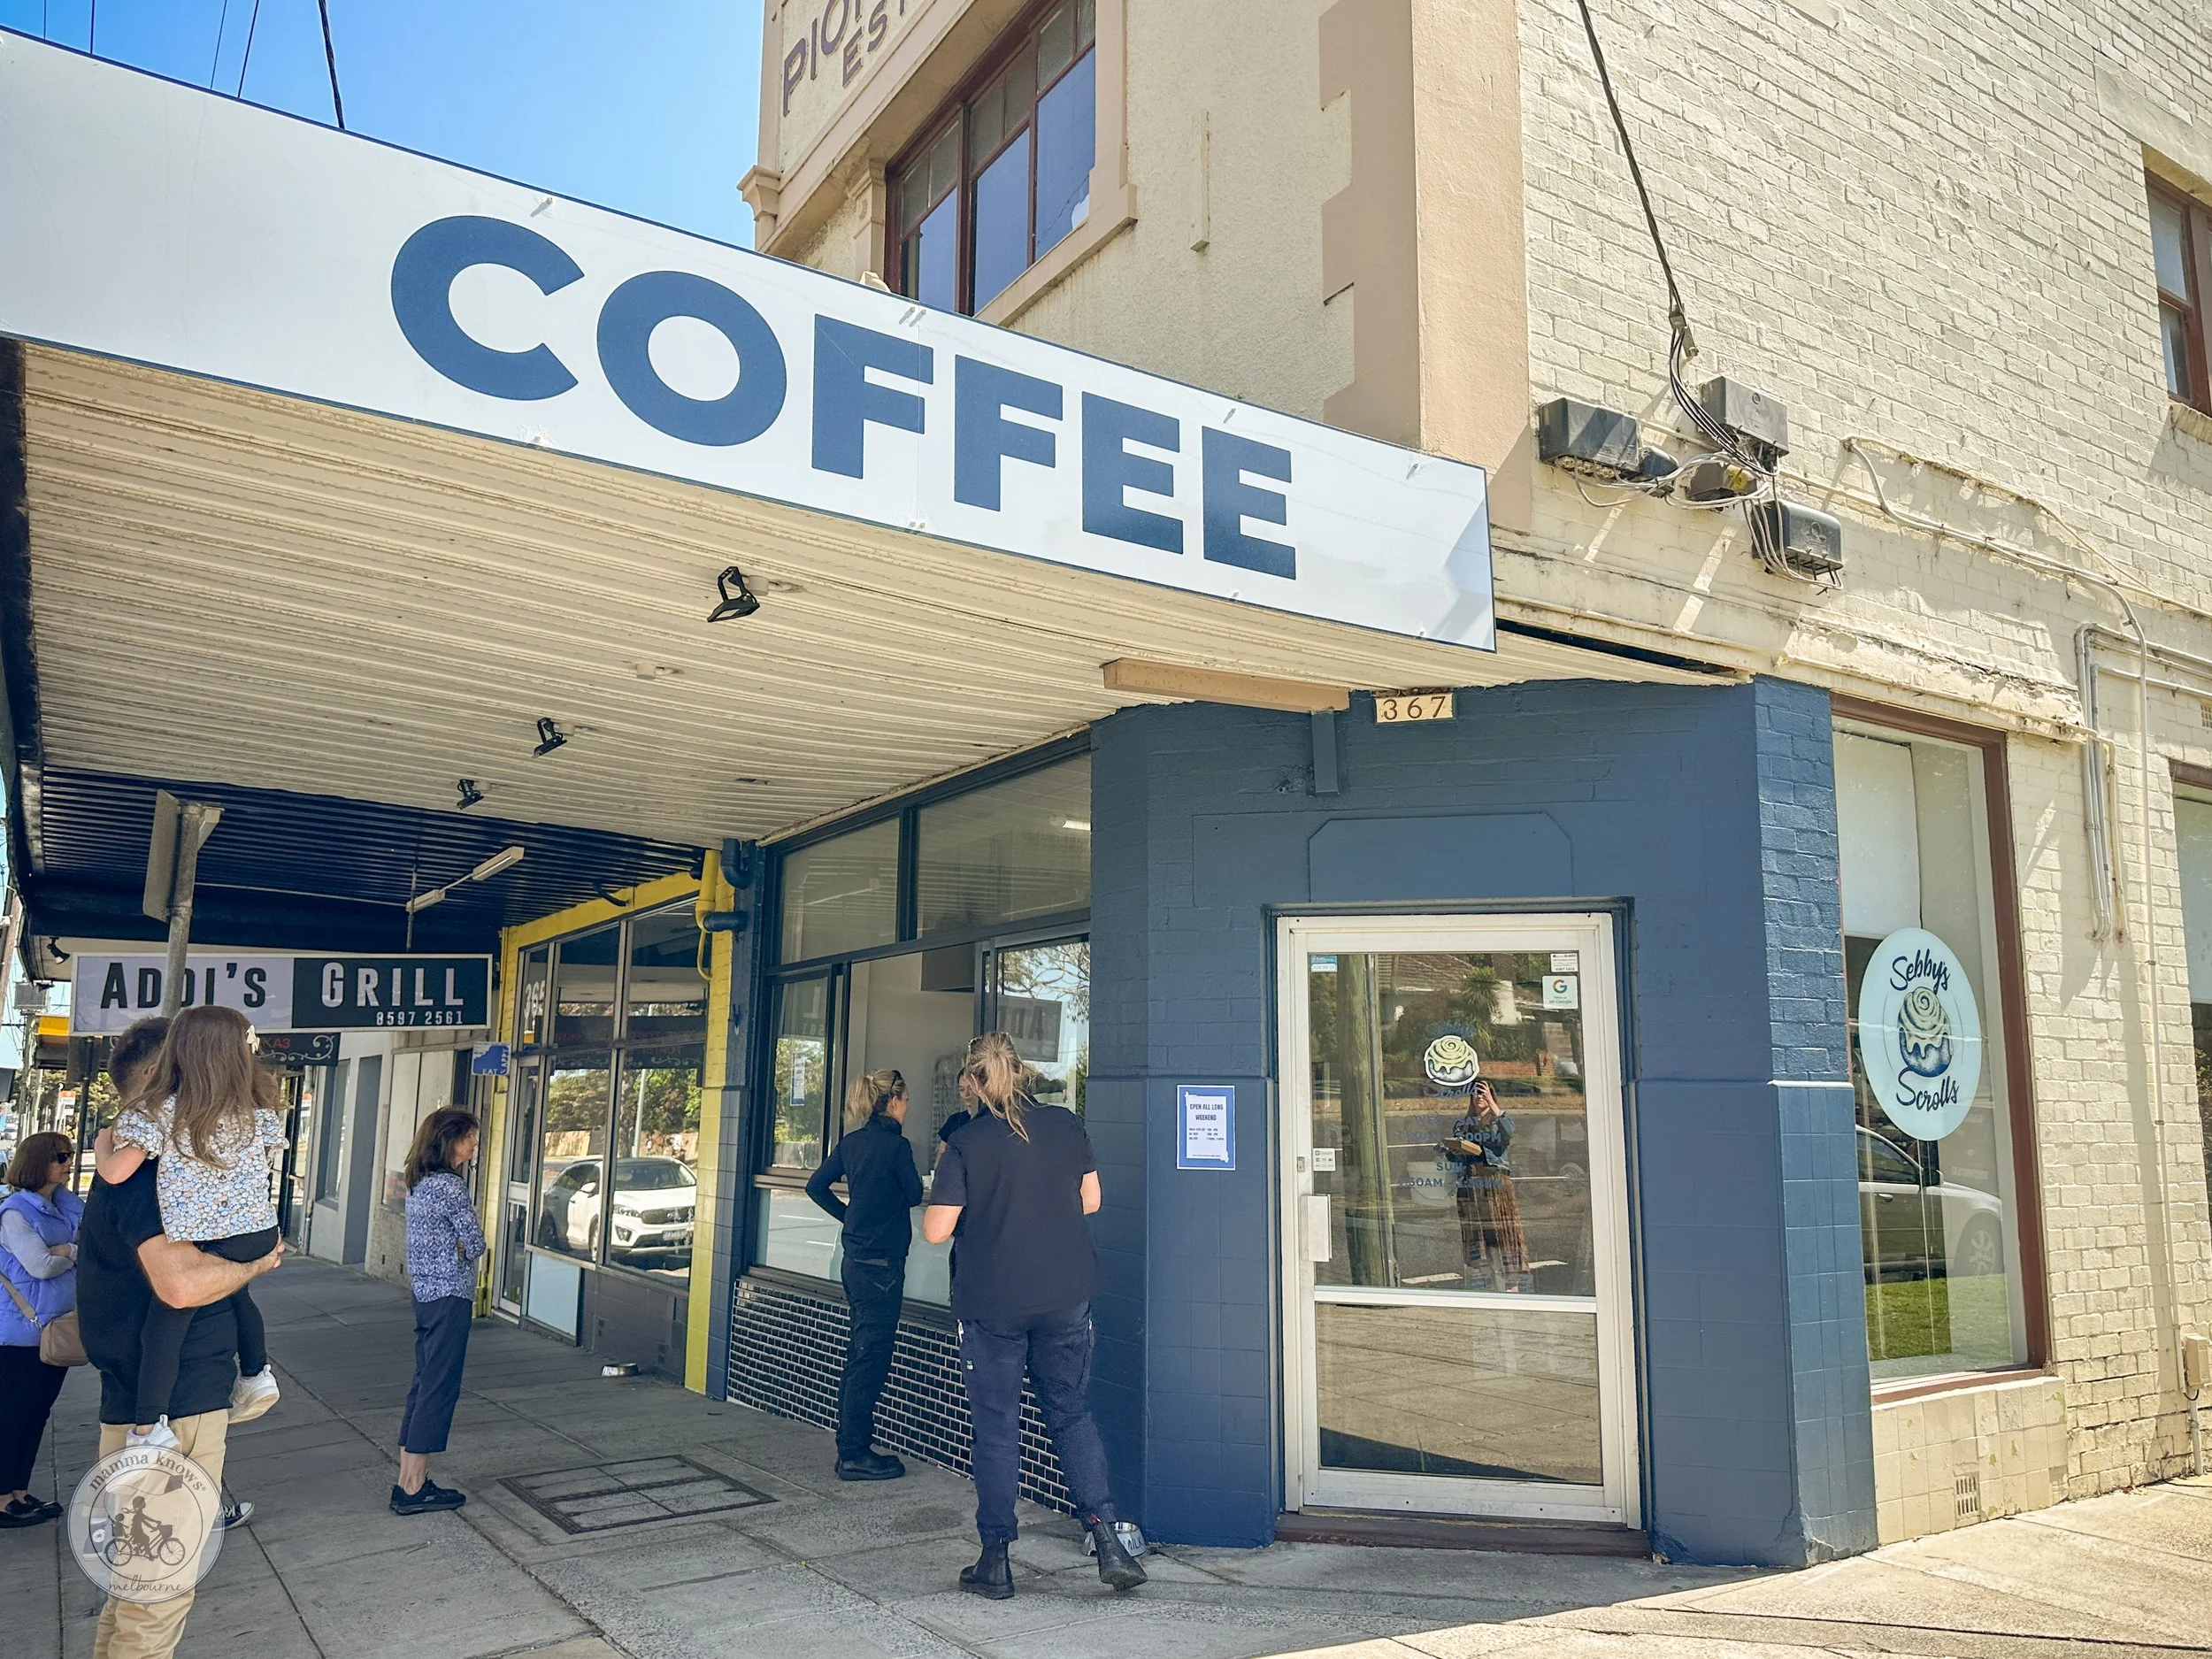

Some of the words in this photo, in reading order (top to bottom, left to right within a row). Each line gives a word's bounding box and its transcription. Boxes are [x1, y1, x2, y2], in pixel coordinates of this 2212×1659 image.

[783, 0, 862, 117] PIO
[842, 0, 905, 88] ES
[390, 214, 1296, 580] COFFEE
[1382, 695, 1447, 720] 367
[321, 962, 465, 1009] GRILL
[1889, 948, 1951, 995] Sebby's
[376, 1010, 416, 1026] 8597
[424, 1010, 464, 1025] 2561
[1895, 1065, 1960, 1112] Scrolls
